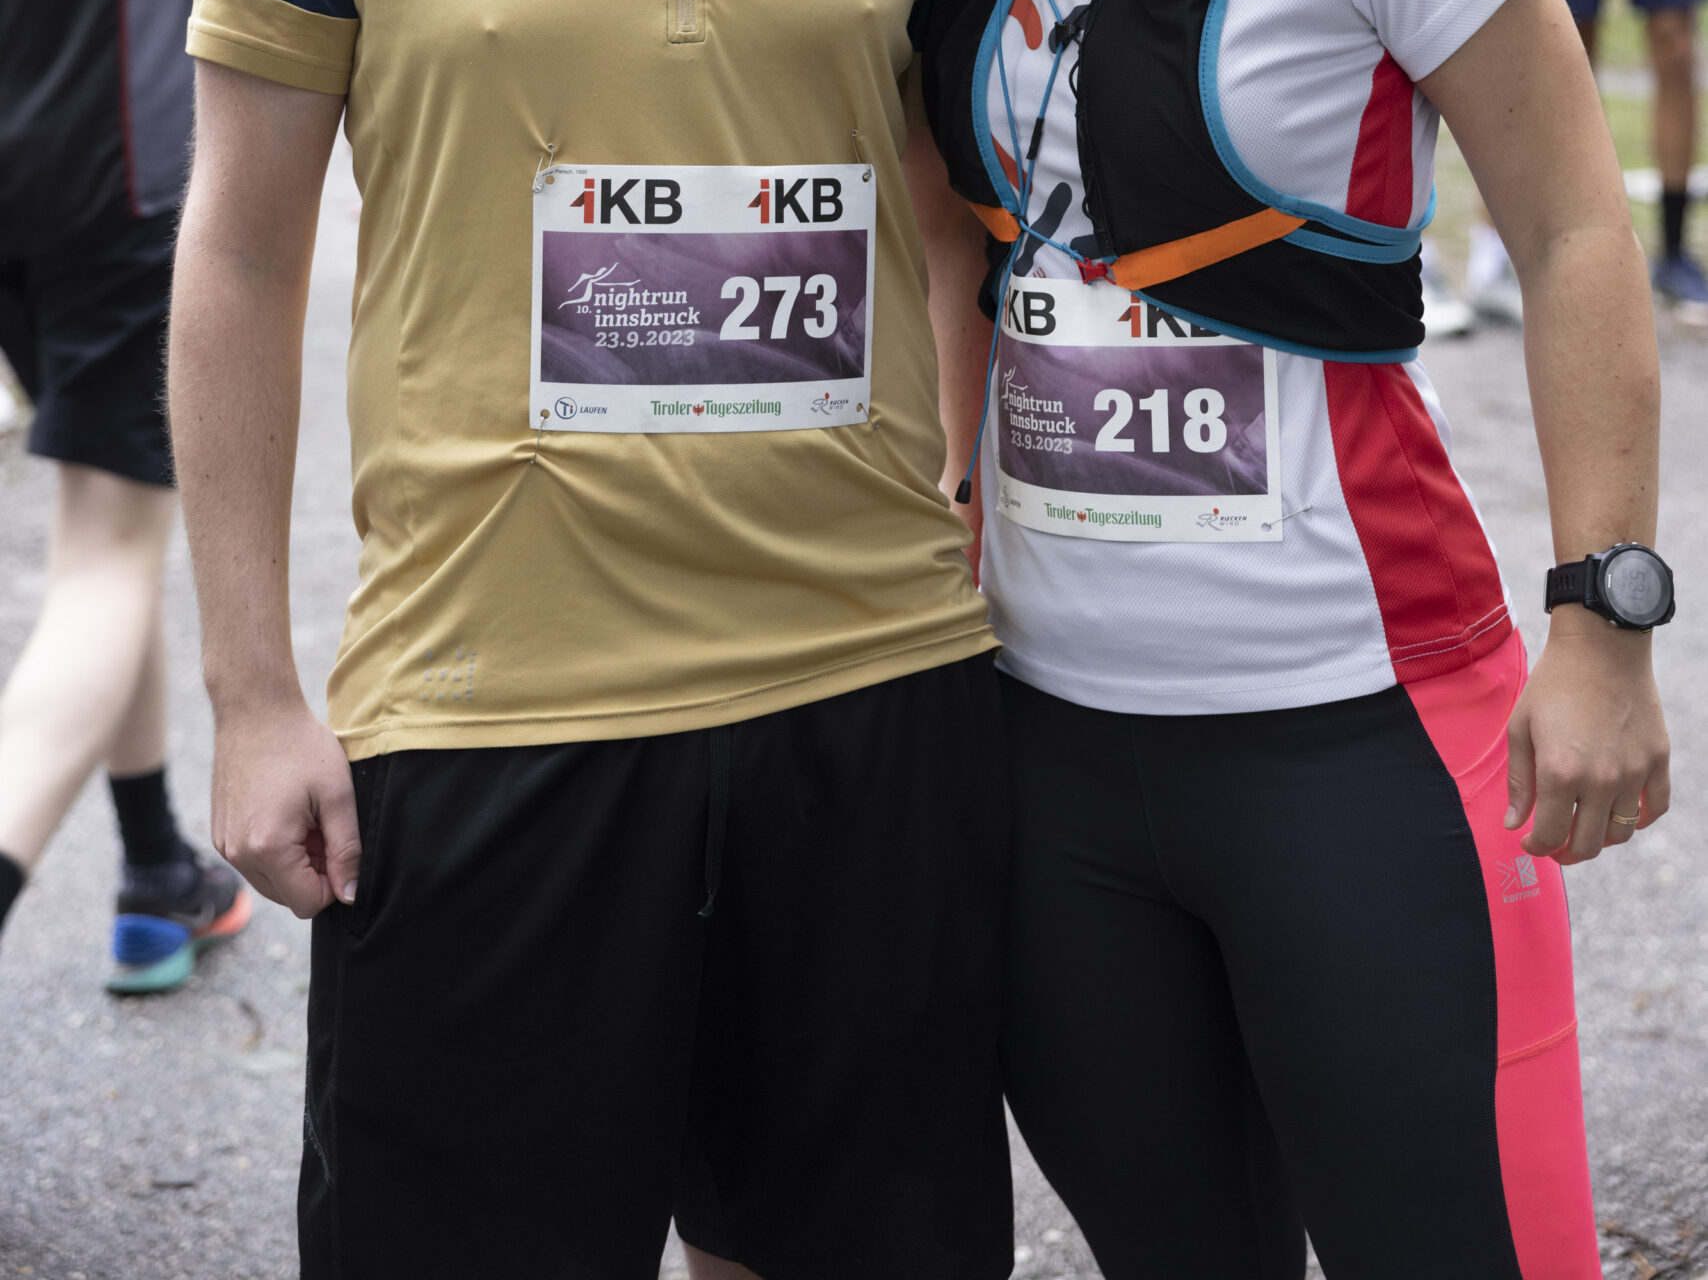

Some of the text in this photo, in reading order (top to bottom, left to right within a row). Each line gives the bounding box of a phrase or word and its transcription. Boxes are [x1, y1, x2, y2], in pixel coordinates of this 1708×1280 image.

[576, 305, 592, 314] 10.
[593, 287, 688, 311] nightrun
[719, 274, 839, 341] 273
[594, 306, 700, 328] innsbruck
[594, 329, 695, 349] 23.9.2023
[580, 406, 608, 414] LAUFEN
[650, 399, 782, 418] Tiroler Tageszeitung
[1008, 389, 1064, 414] nightrun
[1009, 407, 1076, 434] innsbruck
[1093, 387, 1228, 454] 218
[1011, 430, 1073, 454] 23.9.2023
[1044, 502, 1162, 529] Tiroler Tageszeitung
